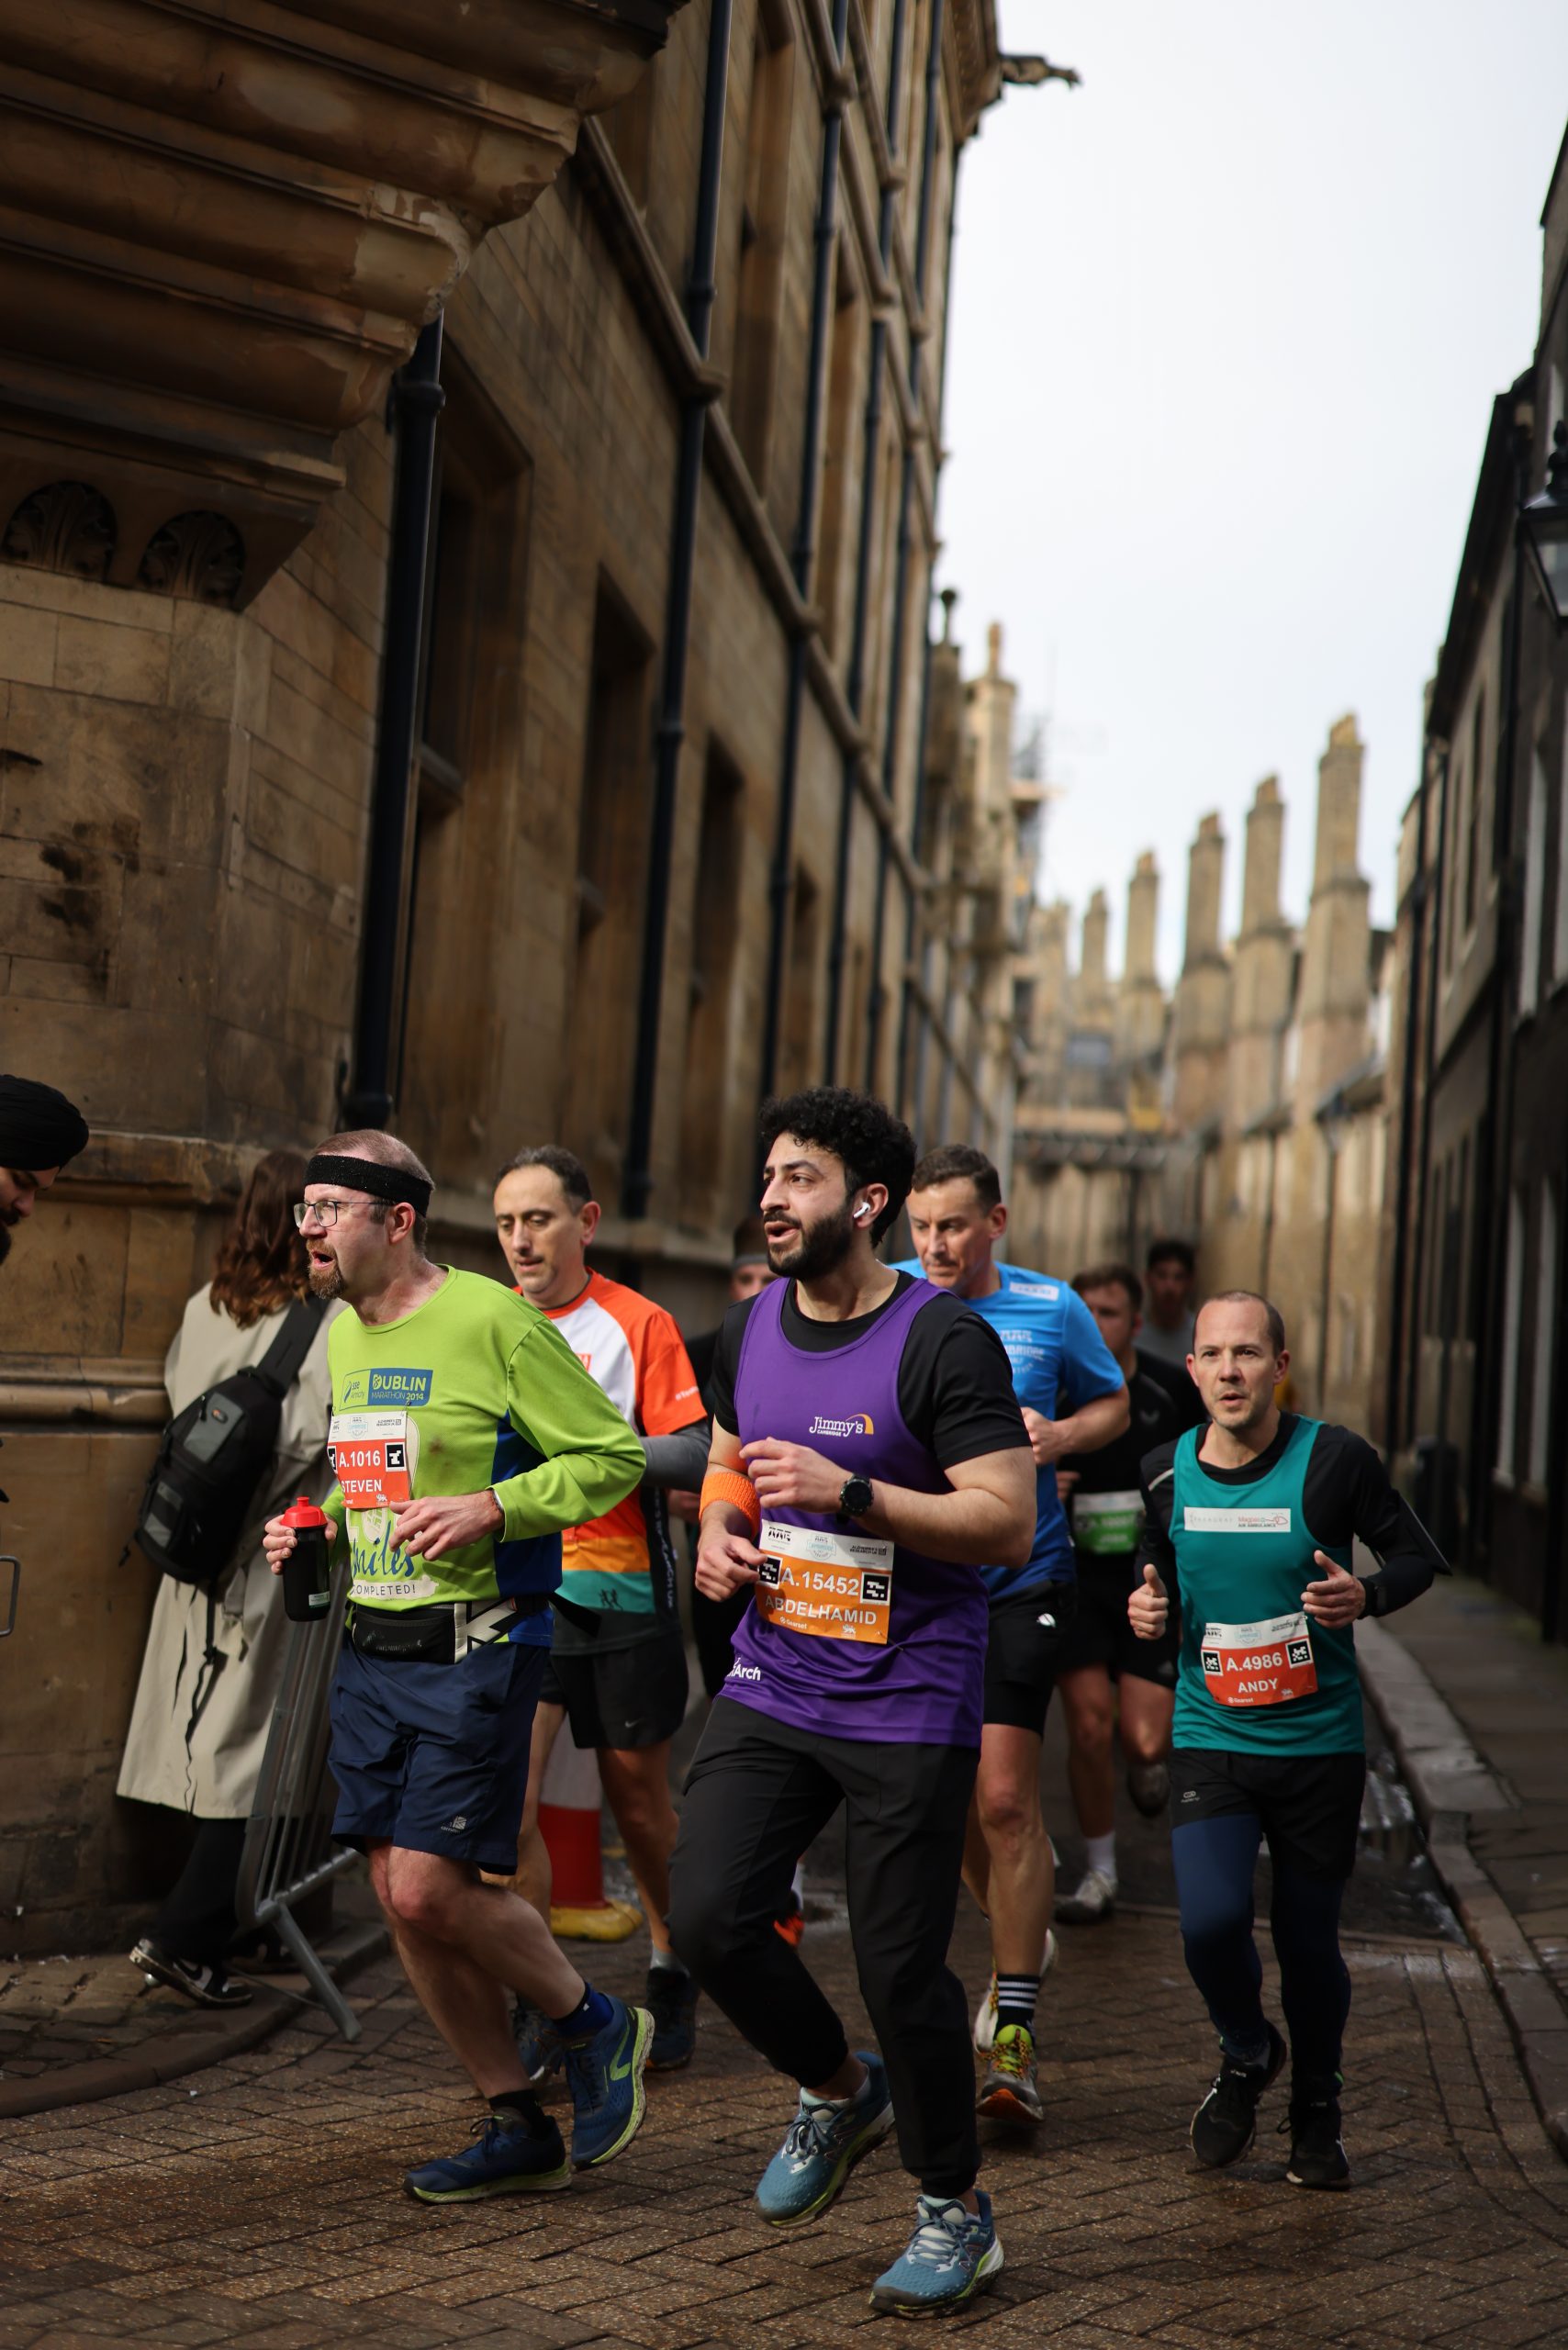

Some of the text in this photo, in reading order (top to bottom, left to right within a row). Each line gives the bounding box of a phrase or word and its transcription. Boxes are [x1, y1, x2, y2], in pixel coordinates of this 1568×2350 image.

[372, 1373, 427, 1391] DUBLIN
[371, 1391, 406, 1400] MARATHON
[406, 1393, 424, 1401] 2014
[809, 1416, 863, 1437] Jimmy's
[339, 1450, 381, 1468] A.1016
[341, 1479, 382, 1494] STEVEN
[780, 1567, 860, 1596] A.15452
[766, 1595, 877, 1625] ABDELHAMID
[786, 1618, 808, 1630] Gearset
[1226, 1652, 1282, 1672] A.4986
[1238, 1677, 1278, 1693] ANDY
